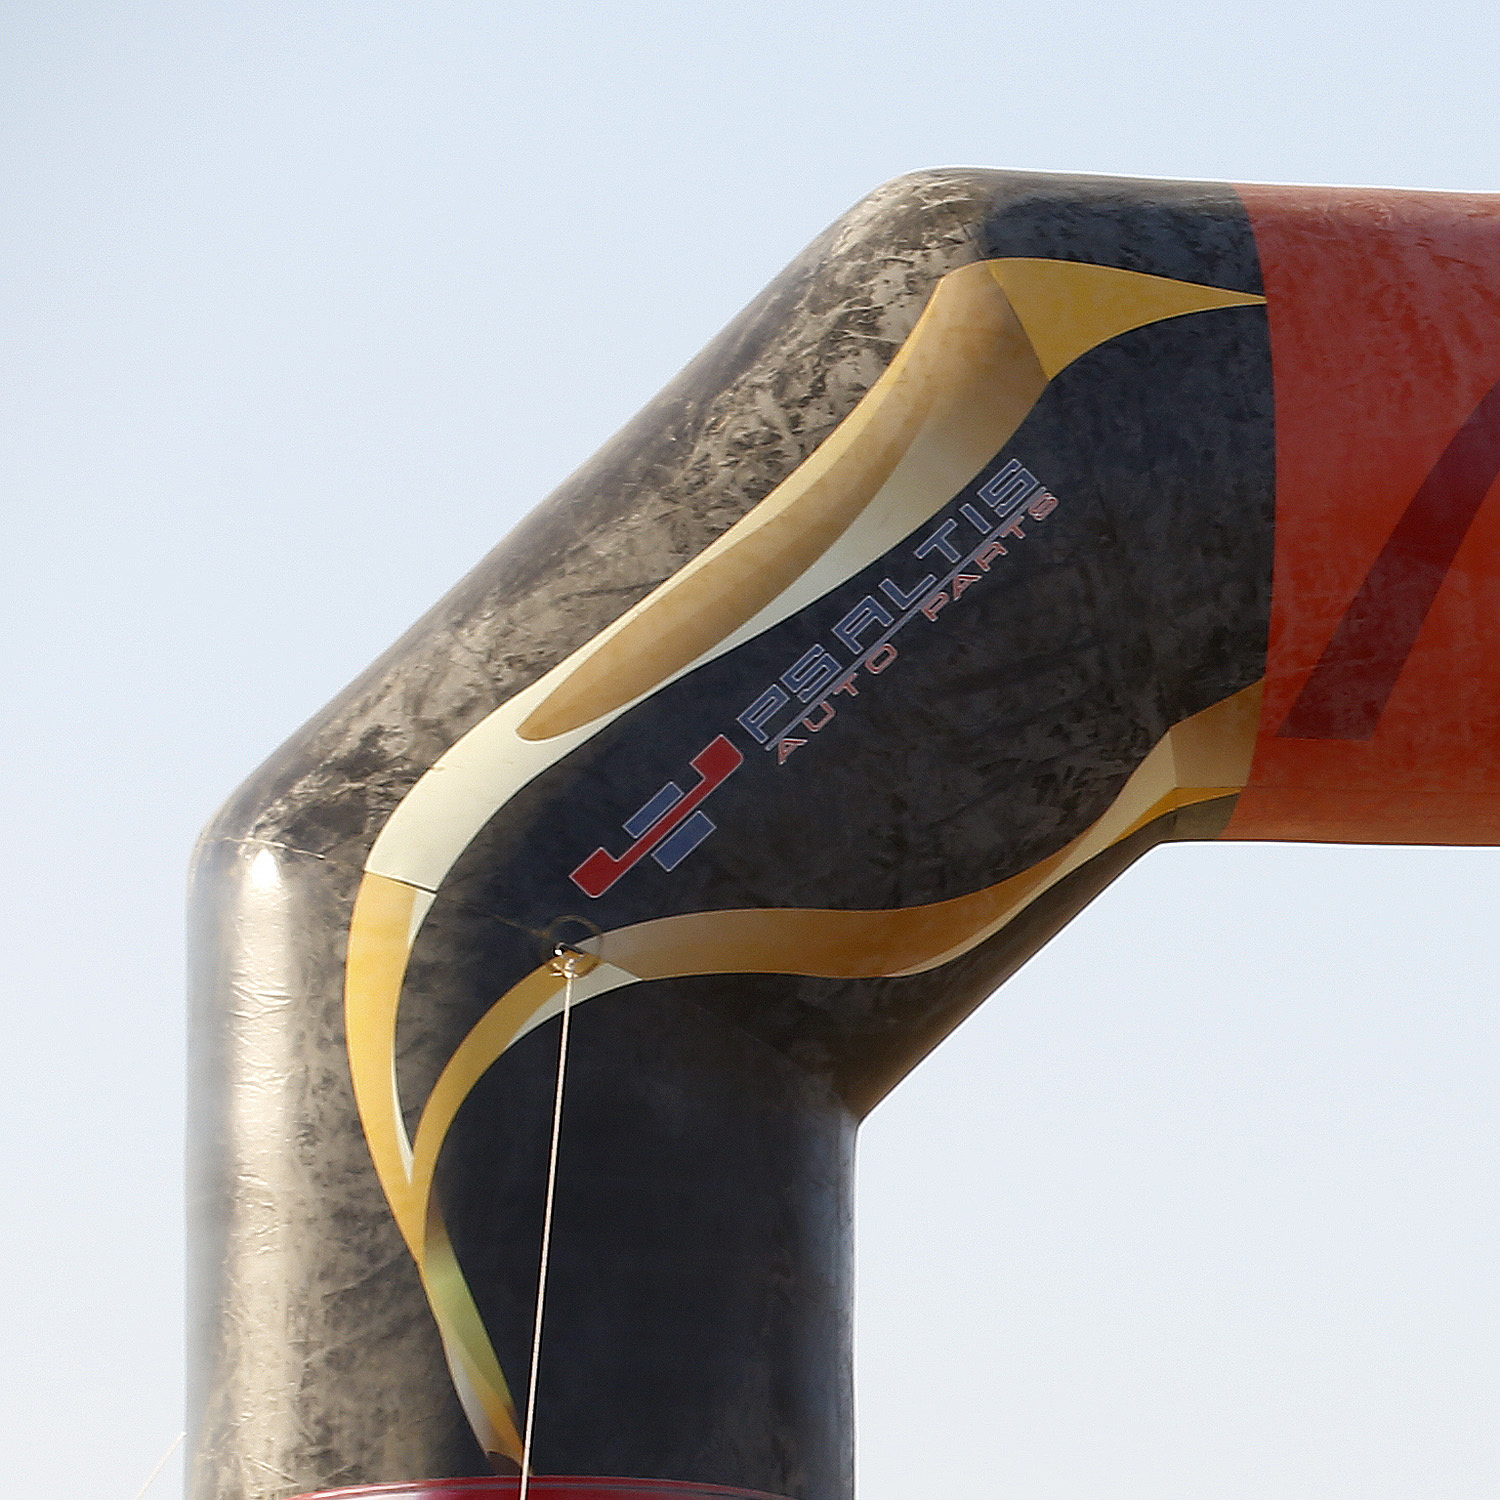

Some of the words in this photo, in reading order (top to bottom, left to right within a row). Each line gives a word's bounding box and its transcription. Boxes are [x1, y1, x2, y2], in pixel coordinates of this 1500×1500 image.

[736, 458, 1041, 744] PSALTIS
[776, 643, 899, 765] AUTO
[921, 492, 1060, 622] PARTS
